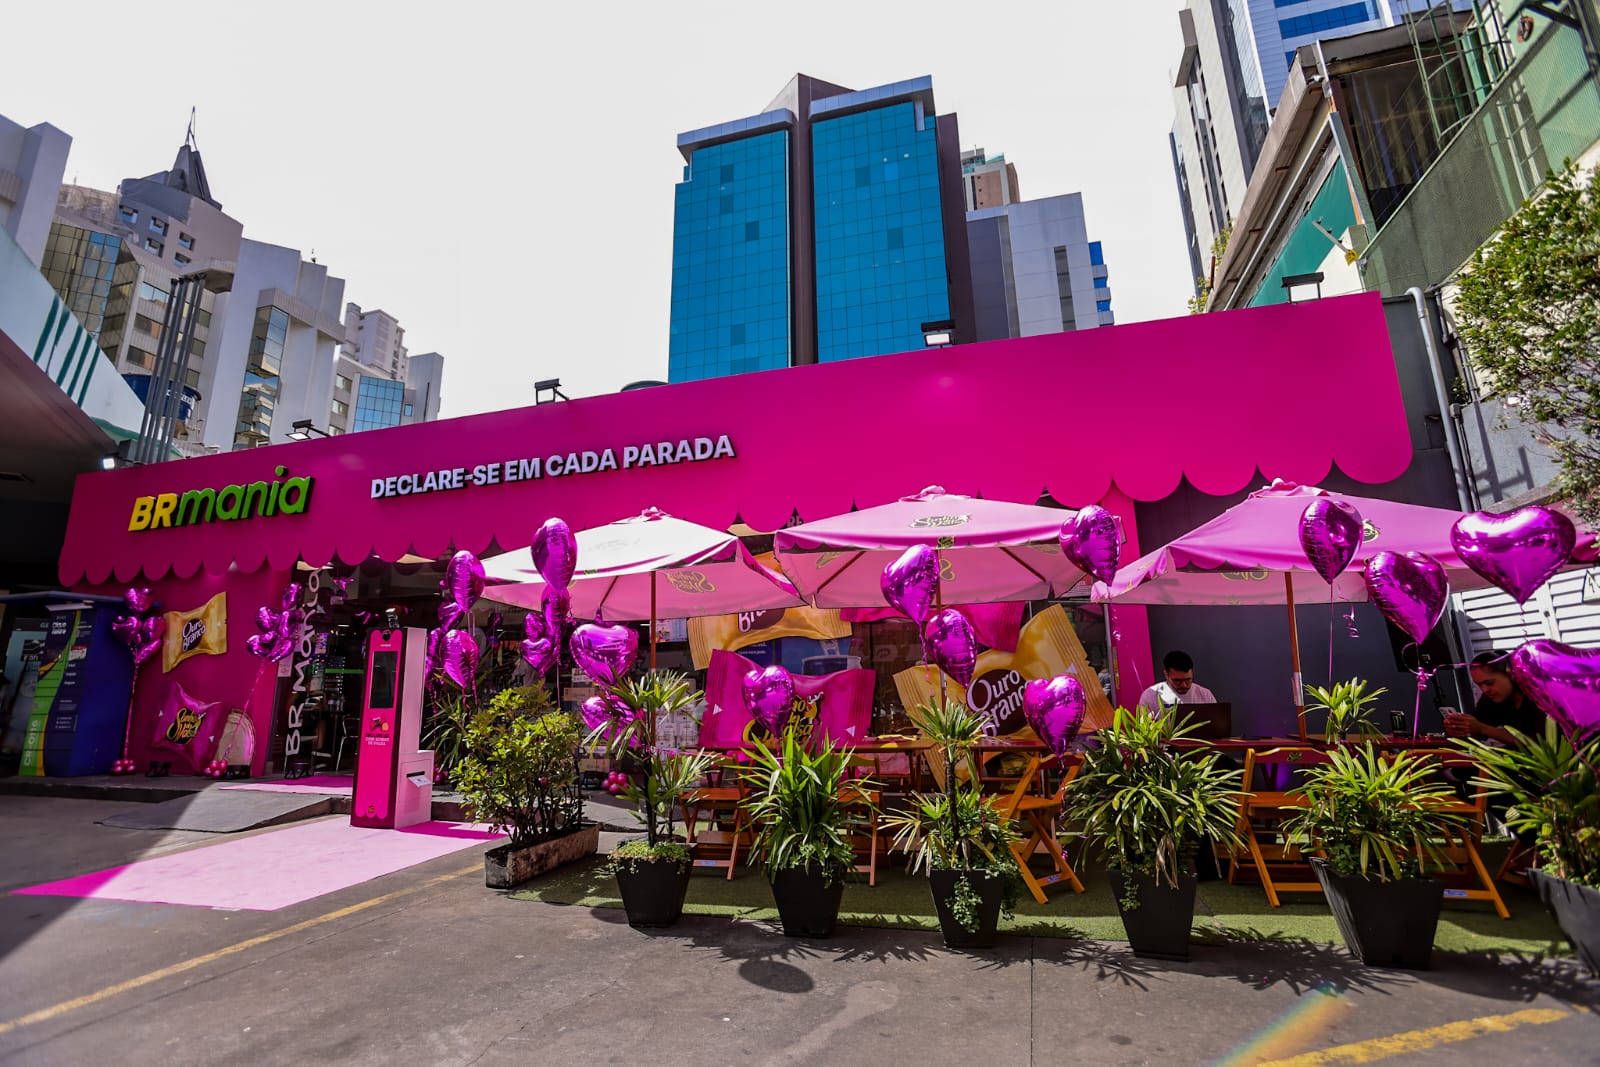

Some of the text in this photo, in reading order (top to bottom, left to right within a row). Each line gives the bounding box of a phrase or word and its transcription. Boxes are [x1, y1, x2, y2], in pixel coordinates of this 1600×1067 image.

[371, 434, 736, 499] DECLARE-SE EM CADA PARADA
[127, 464, 313, 532] BRmania
[183, 619, 203, 638] Ouro
[966, 669, 1021, 713] Ouro
[285, 702, 306, 757] BR
